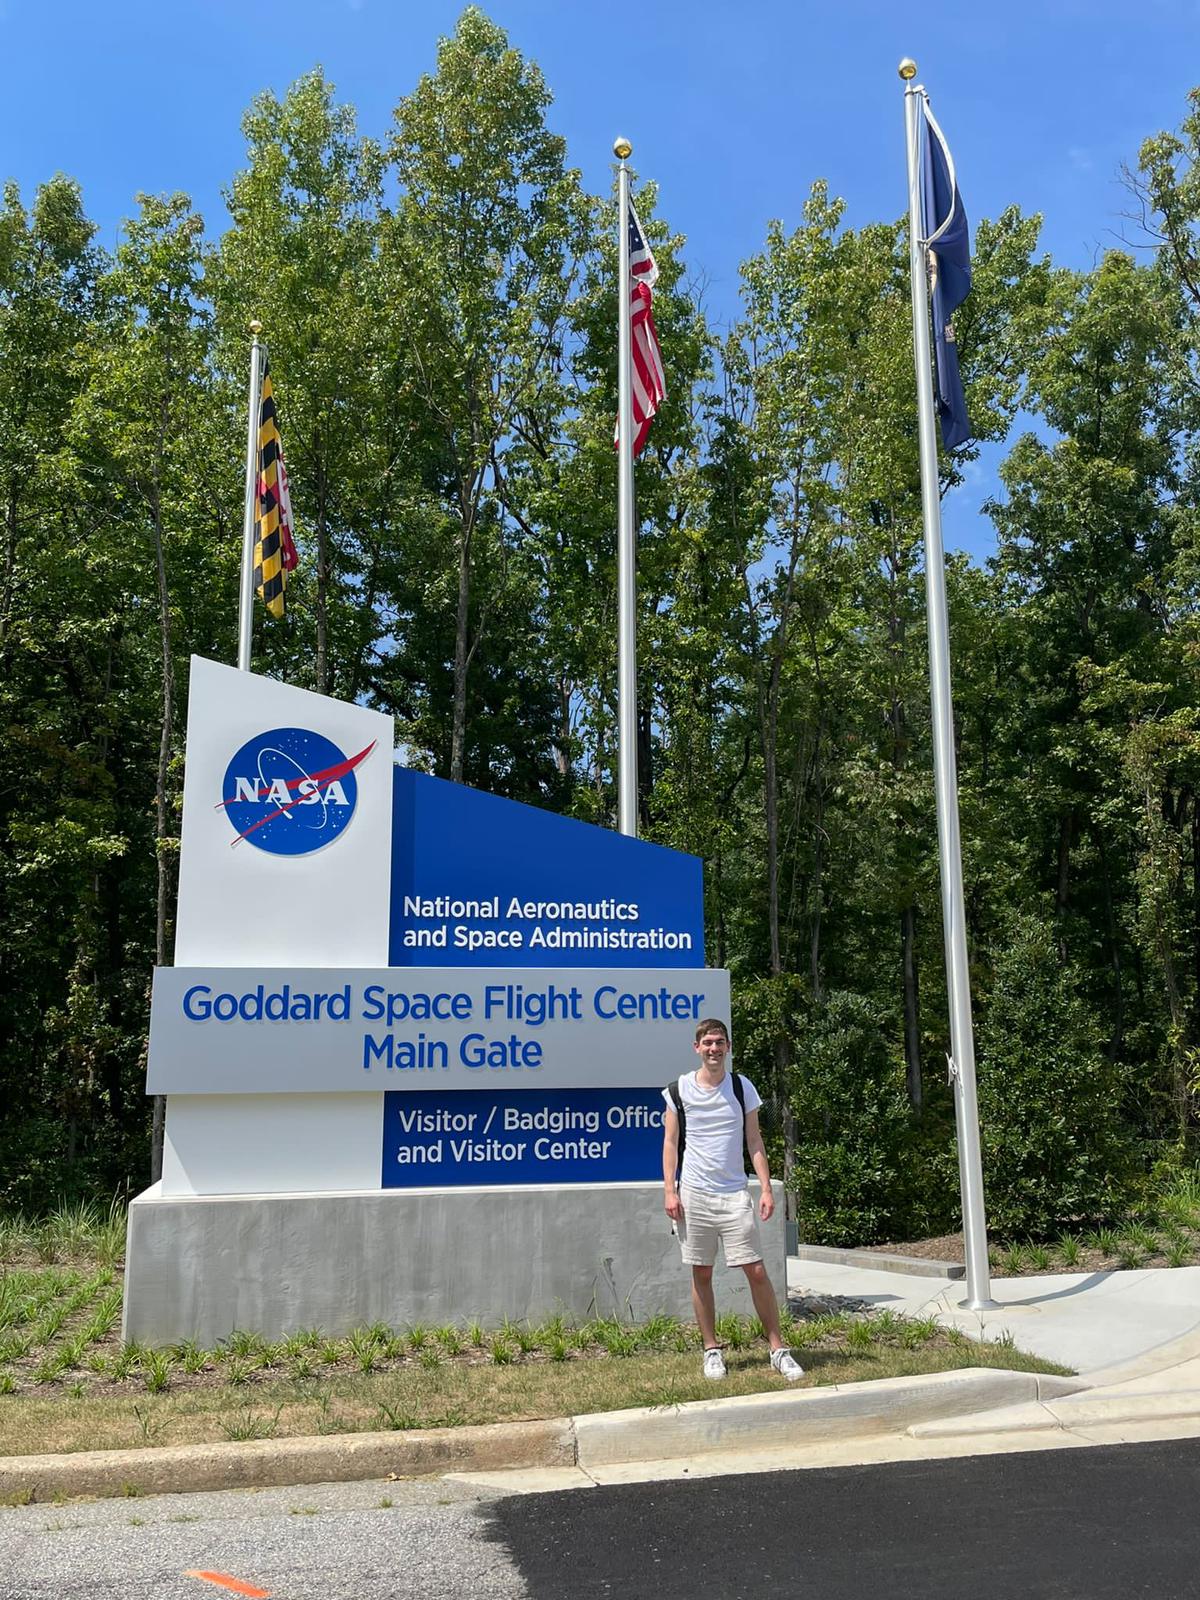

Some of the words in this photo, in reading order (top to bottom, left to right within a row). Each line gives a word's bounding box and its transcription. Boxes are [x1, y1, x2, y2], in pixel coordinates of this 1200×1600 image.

[234, 776, 350, 806] NASA
[404, 896, 499, 918] National
[506, 898, 639, 921] Aeronautics
[403, 925, 447, 947] and
[453, 926, 523, 951] Space
[529, 927, 692, 949] Administration
[183, 985, 351, 1021] Goddard
[362, 985, 473, 1026] Space
[484, 985, 582, 1026] Flight
[593, 985, 705, 1020] Center
[363, 1034, 448, 1069] Main
[460, 1034, 543, 1069] Gate
[399, 1110, 478, 1133] Visitor
[483, 1106, 497, 1134] /
[504, 1107, 600, 1134] Badging
[397, 1140, 442, 1164] and
[449, 1138, 527, 1162] Visitor
[534, 1137, 612, 1160] Center
